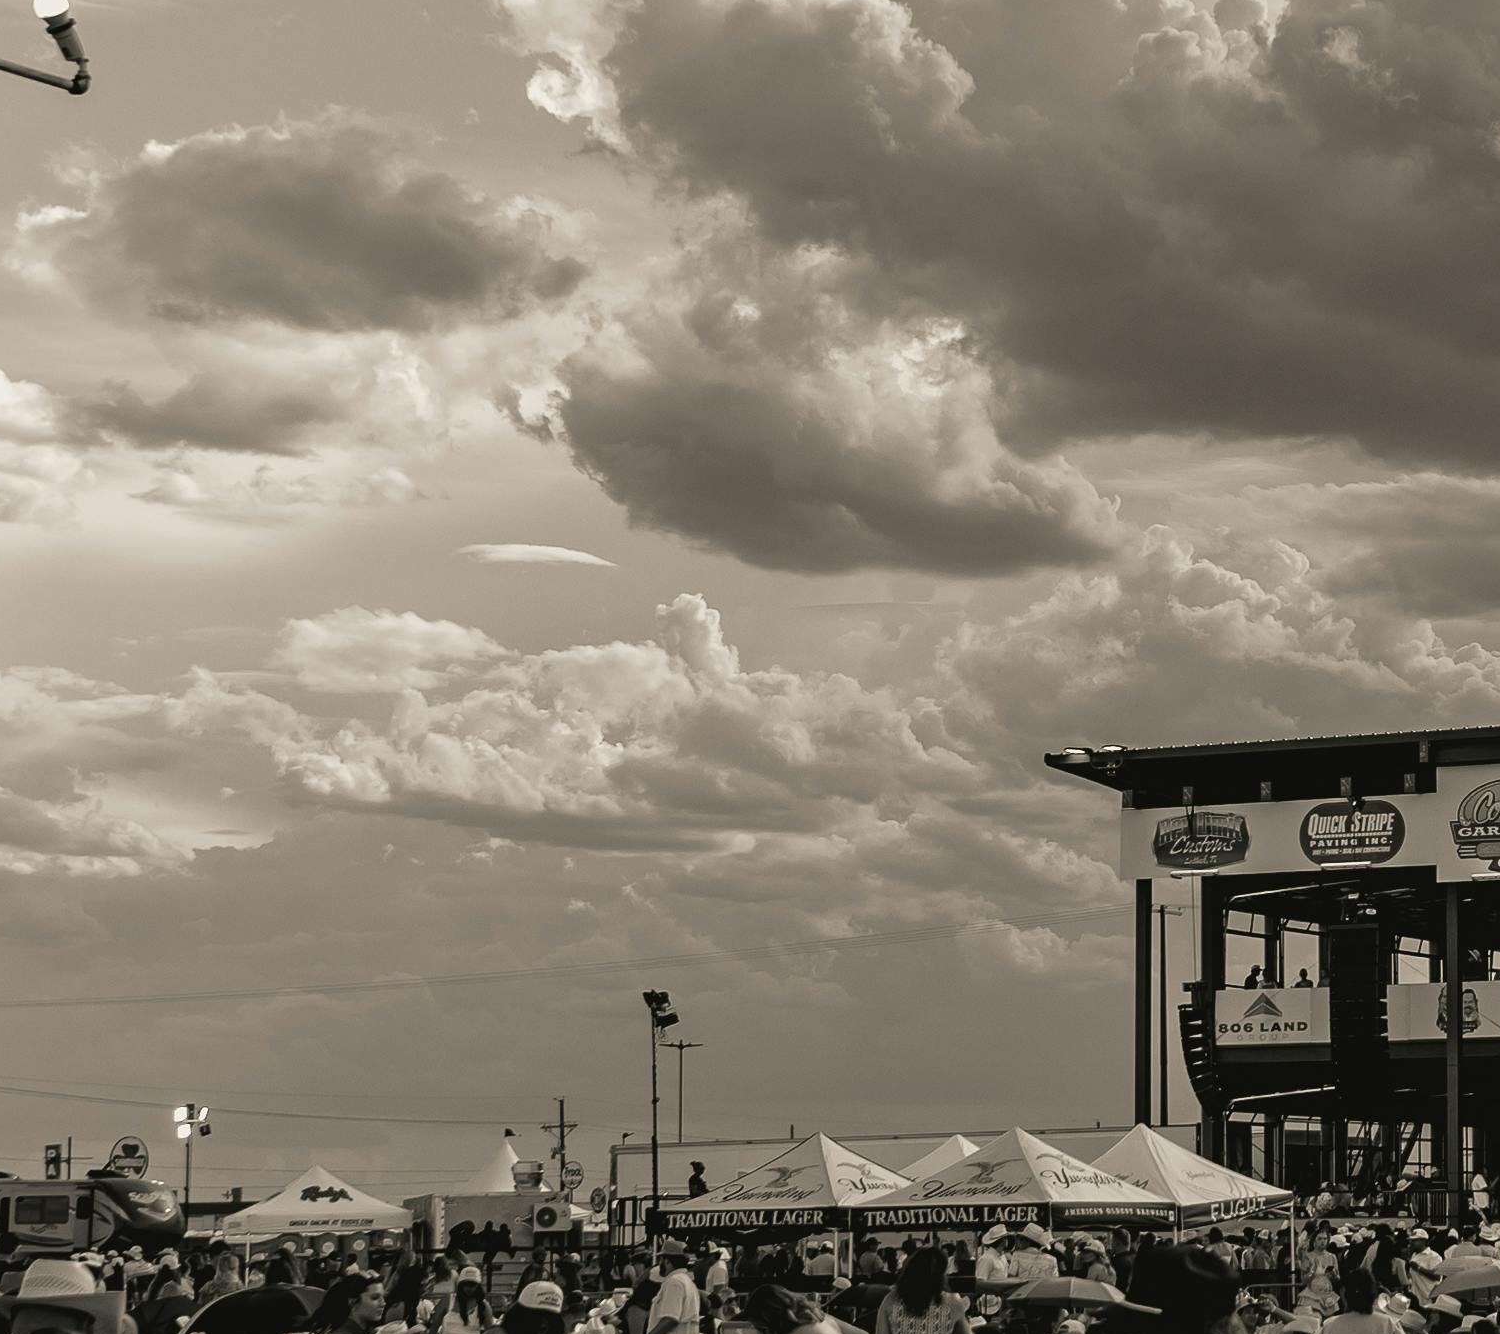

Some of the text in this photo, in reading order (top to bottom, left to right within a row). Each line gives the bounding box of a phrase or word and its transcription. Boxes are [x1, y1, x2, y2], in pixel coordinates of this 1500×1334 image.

[1308, 811, 1395, 836] QUICK STRIPE
[1170, 835, 1236, 855] Customs
[1310, 837, 1394, 848] PAVING INC.
[1218, 1021, 1308, 1033] 806 LAND
[1237, 1033, 1289, 1042] GROUP
[666, 1209, 824, 1228] TRADITIONAL LAGER
[864, 1205, 1039, 1227] TRADITIONAL LAGER
[1210, 1197, 1267, 1223] FLIGHT
